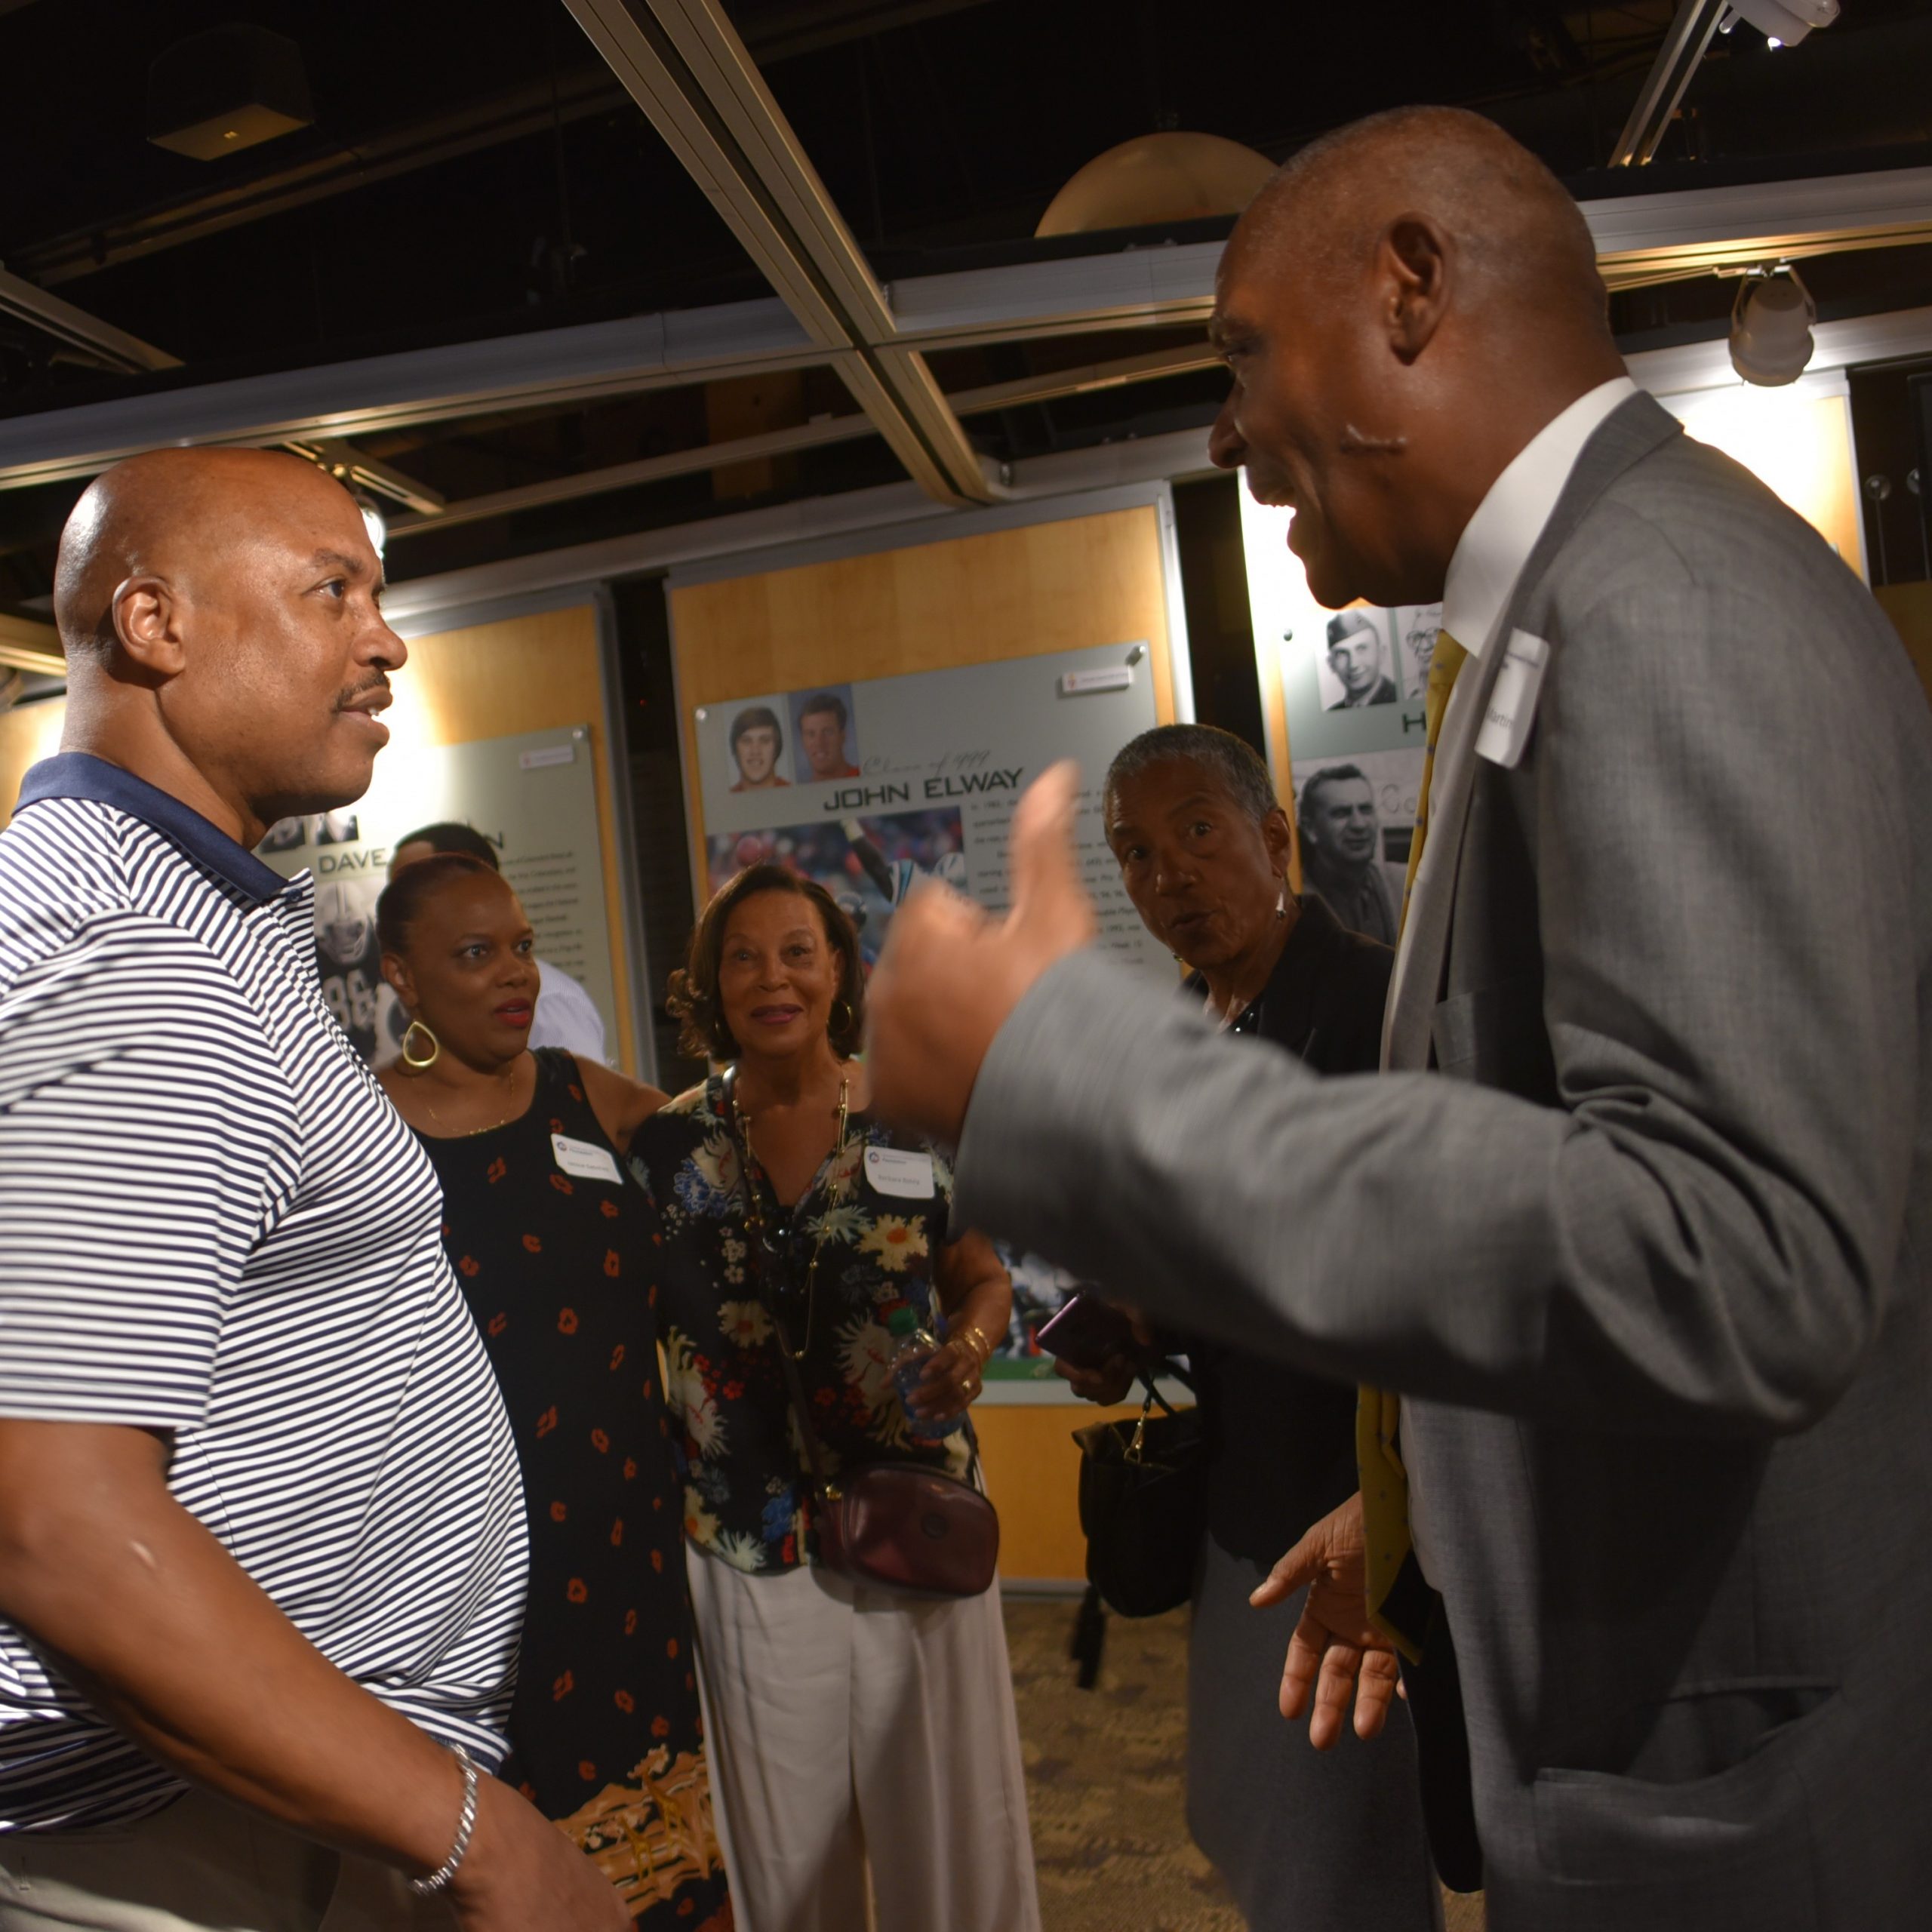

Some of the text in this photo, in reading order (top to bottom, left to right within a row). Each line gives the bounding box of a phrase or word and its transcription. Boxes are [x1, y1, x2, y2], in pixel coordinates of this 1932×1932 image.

[823, 767, 1024, 811] JOHN ELWAY
[318, 848, 388, 874] DAVE
